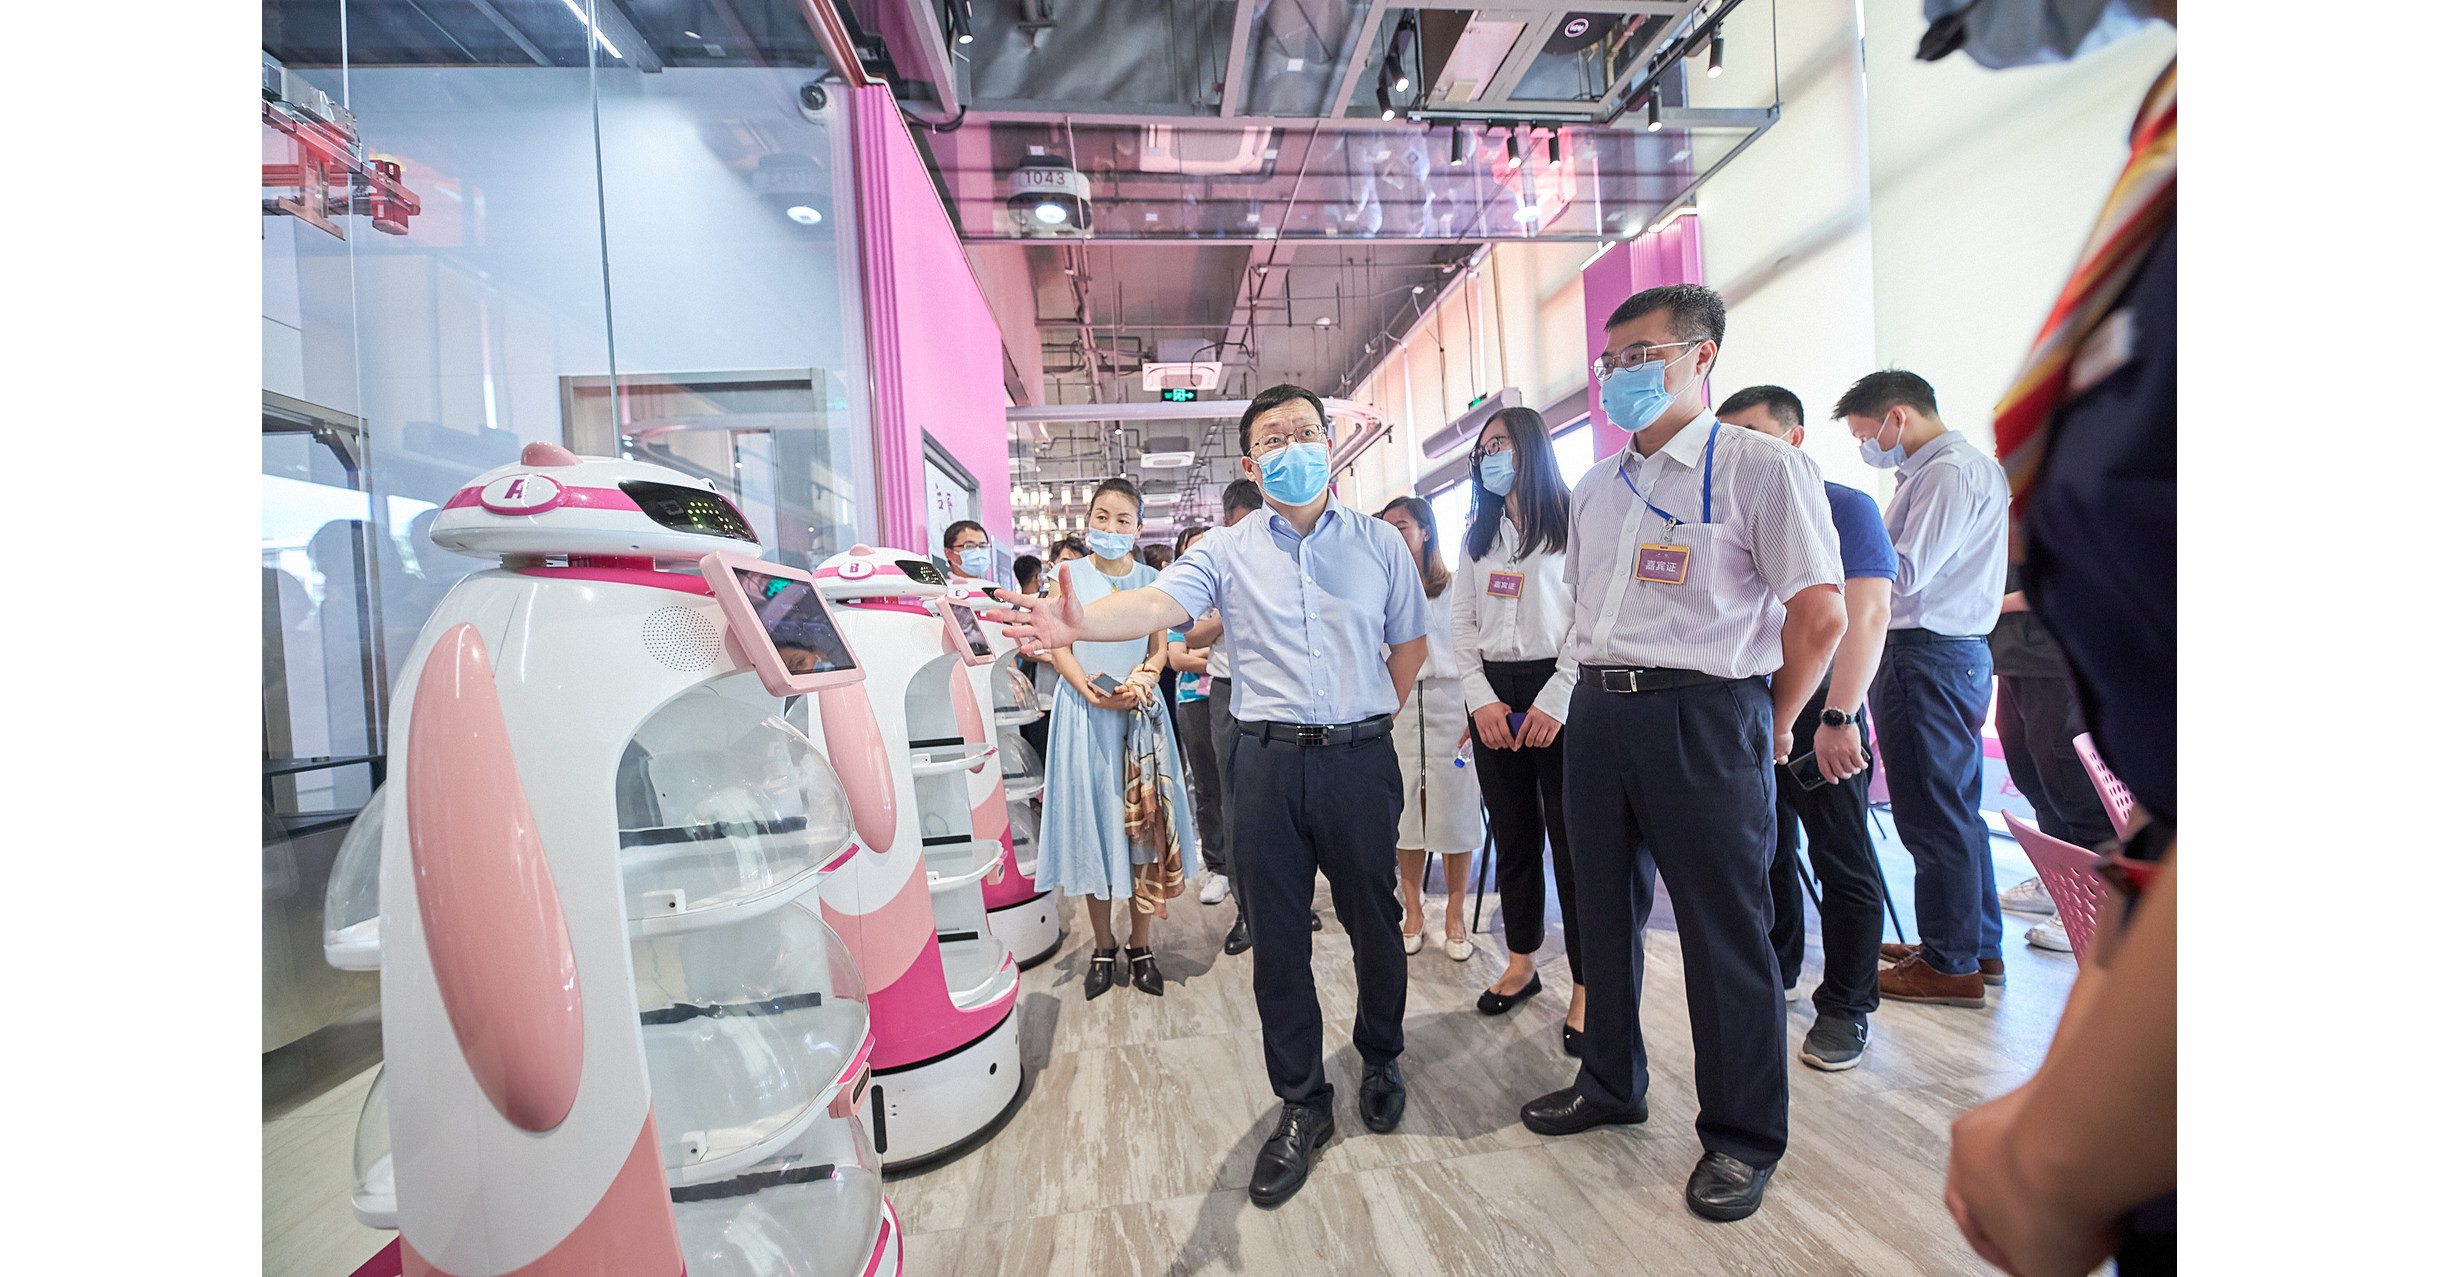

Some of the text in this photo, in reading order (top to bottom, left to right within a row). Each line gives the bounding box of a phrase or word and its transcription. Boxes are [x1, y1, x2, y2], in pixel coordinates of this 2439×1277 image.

[1025, 170, 1065, 185] 1043
[504, 479, 529, 499] A
[850, 563, 859, 573] B
[1646, 560, 1677, 573] 嘉宾证
